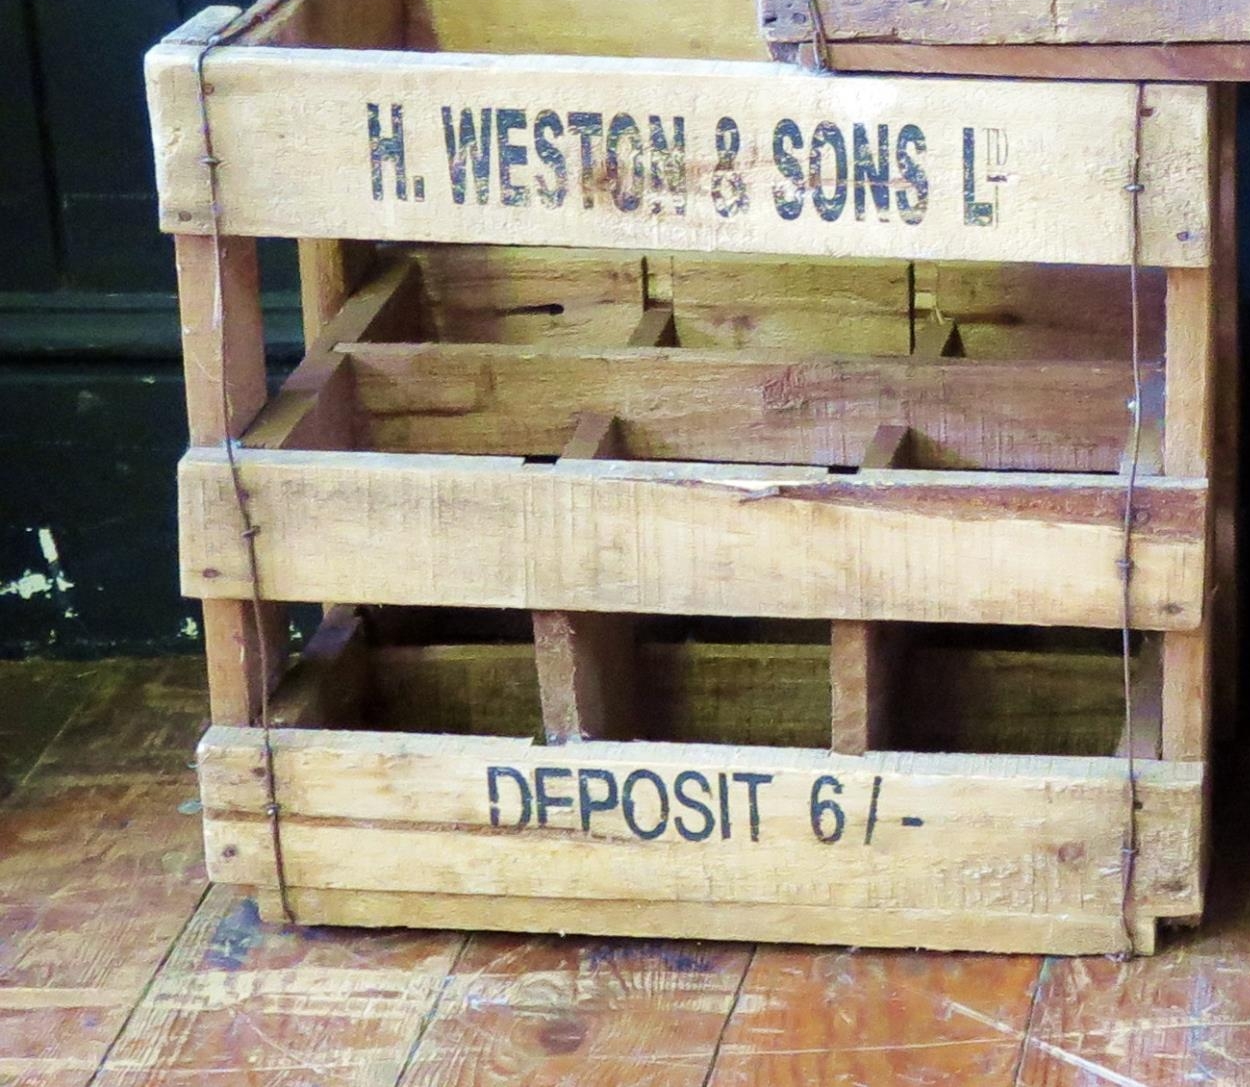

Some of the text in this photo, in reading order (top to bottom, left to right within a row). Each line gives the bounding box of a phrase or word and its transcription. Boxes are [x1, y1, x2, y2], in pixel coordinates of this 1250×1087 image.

[366, 102, 425, 202] H.
[440, 105, 686, 215] WESTON
[711, 115, 749, 218] &
[771, 117, 928, 225] SONS
[486, 765, 775, 843] DEPOSIT
